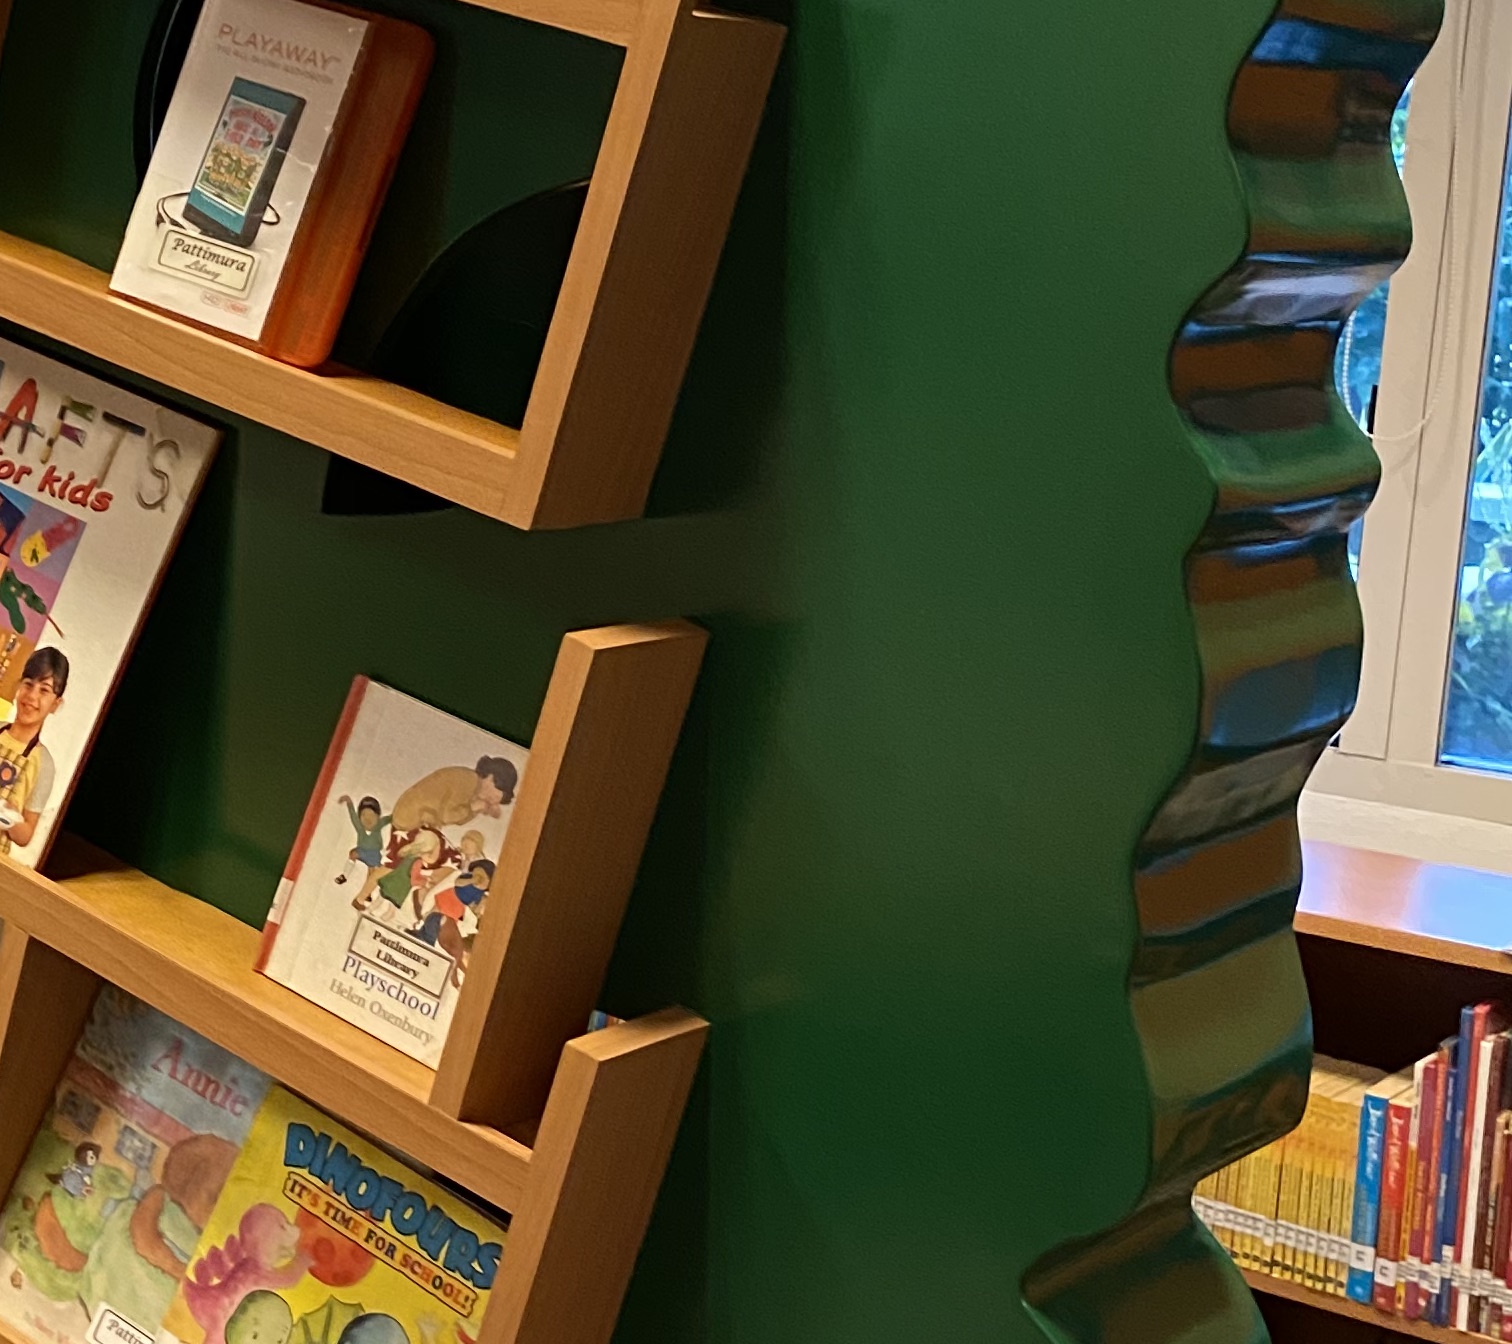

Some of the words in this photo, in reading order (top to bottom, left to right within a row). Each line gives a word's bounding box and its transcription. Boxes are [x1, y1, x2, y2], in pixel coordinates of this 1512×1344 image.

[218, 22, 341, 71] PLAYAWAY
[172, 238, 246, 272] Pattimura
[38, 465, 114, 513] kids
[329, 978, 367, 1008] Helen
[369, 1000, 436, 1047] Oxenbury
[342, 956, 440, 1020] Playschool
[151, 1036, 251, 1117] Annie
[284, 1122, 503, 1290] DINOFOURS
[289, 1178, 319, 1206] IT'S
[323, 1200, 362, 1237] TIME
[364, 1230, 397, 1260] FOR
[399, 1253, 471, 1310] SCHOOL!
